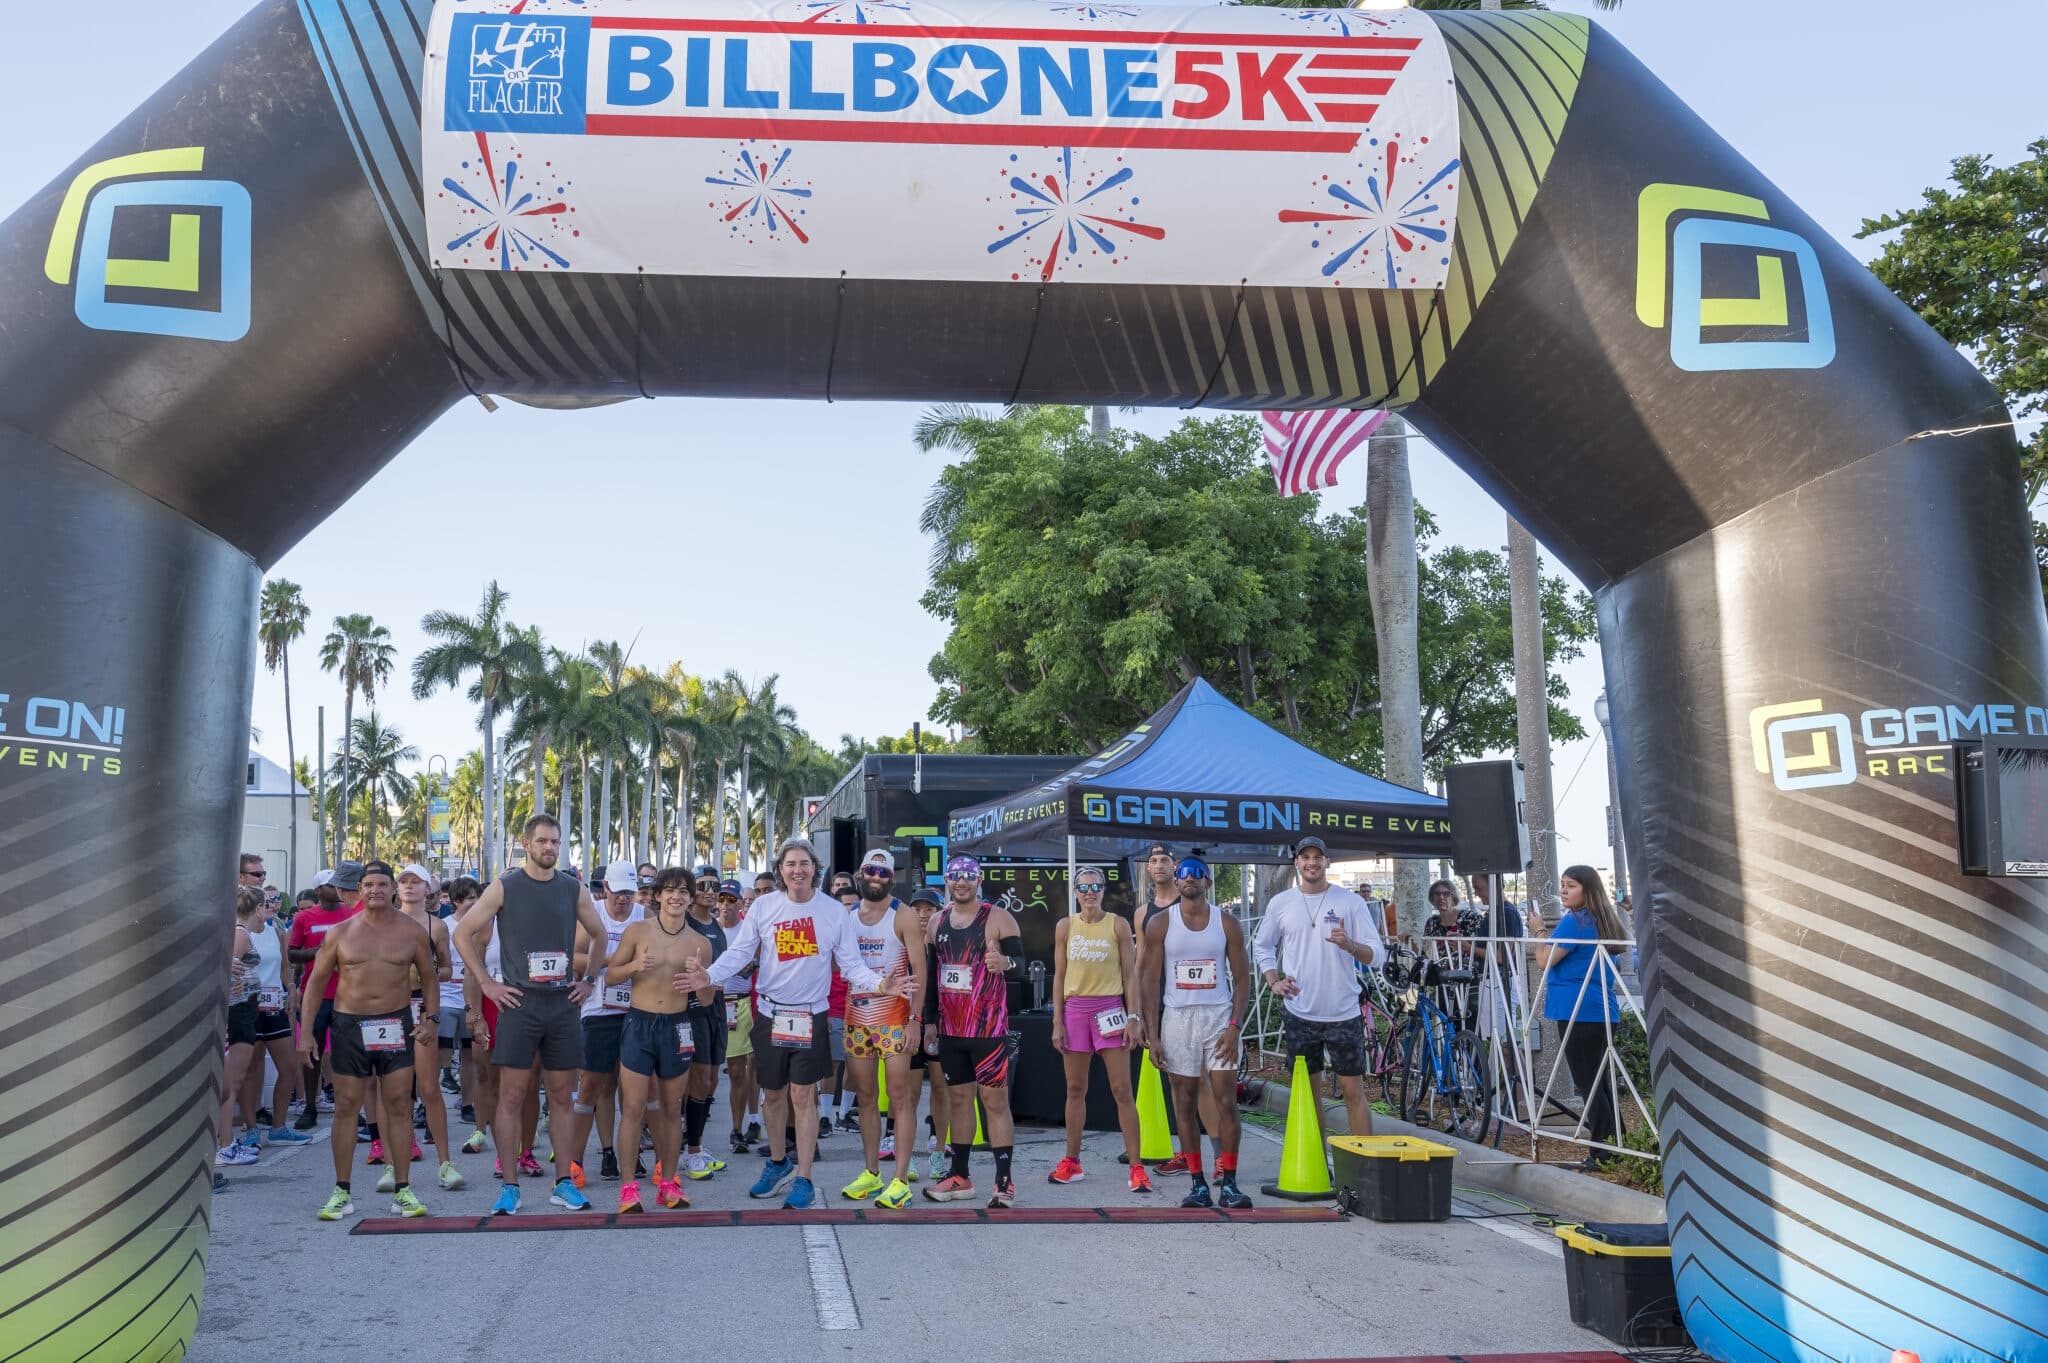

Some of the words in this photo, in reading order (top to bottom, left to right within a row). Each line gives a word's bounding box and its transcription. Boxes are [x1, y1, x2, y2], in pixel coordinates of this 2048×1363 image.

[507, 70, 525, 80] on
[467, 79, 564, 115] FLAGLER
[25, 697, 125, 745] ON!
[1861, 704, 2019, 747] GAME
[1868, 755, 1946, 777] RAC
[956, 811, 985, 841] GAME
[985, 805, 1006, 836] ON!
[1004, 809, 1024, 825] RACE
[1027, 800, 1065, 820] EVENTS
[1116, 795, 1229, 829] GAME
[1238, 801, 1300, 832] ON!
[1309, 812, 1374, 829] RACE
[1388, 818, 1451, 834] EVEN
[773, 916, 813, 930] TEAM
[777, 930, 810, 943] BILL
[1071, 935, 1111, 947] Choose
[776, 941, 819, 956] BONE
[859, 943, 885, 951] DEPOT
[1070, 946, 1108, 962] Happy
[542, 959, 557, 971] 37
[947, 971, 959, 984] 26
[1188, 967, 1203, 979] 67
[615, 991, 630, 1003] 59
[787, 1018, 794, 1031] 1
[1106, 1014, 1125, 1027] 101
[378, 1027, 387, 1039] 2
